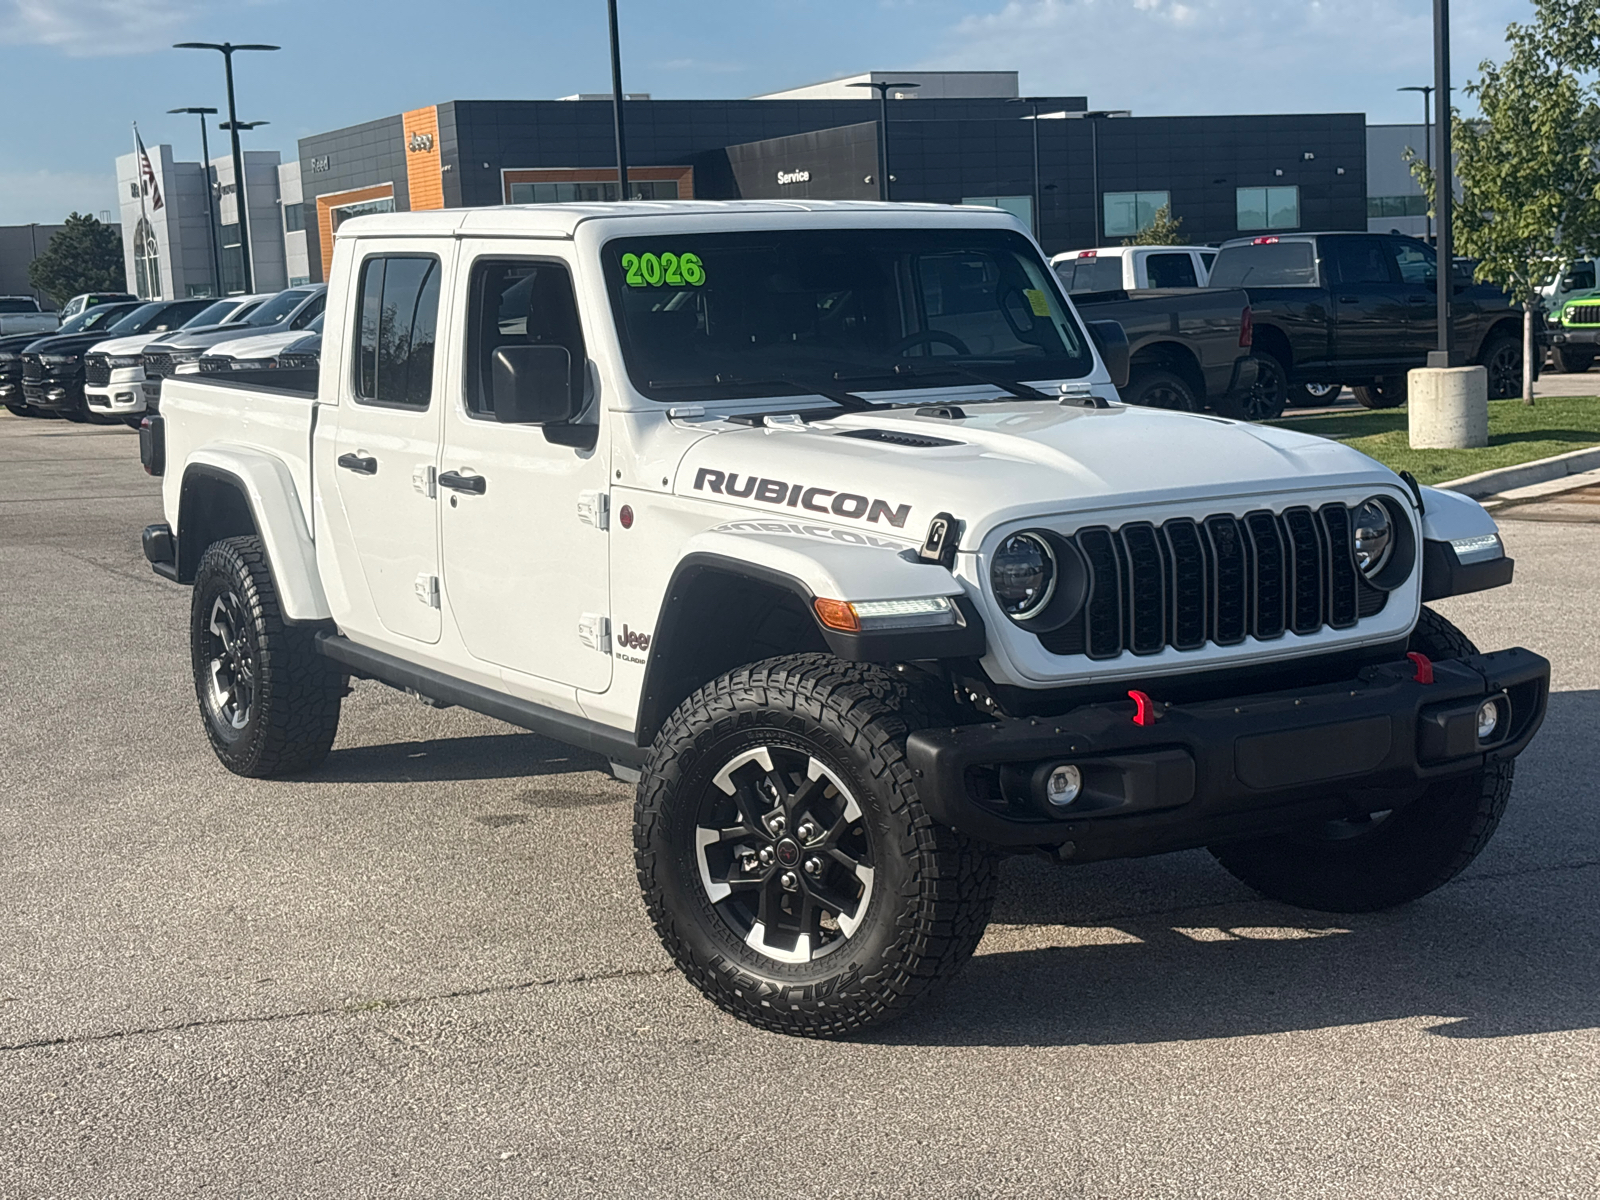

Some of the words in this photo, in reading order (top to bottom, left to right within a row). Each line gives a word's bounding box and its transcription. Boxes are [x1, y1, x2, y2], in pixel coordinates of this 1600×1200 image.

[777, 169, 810, 185] Service
[621, 252, 706, 287] 2026
[693, 467, 912, 528] RUBICON
